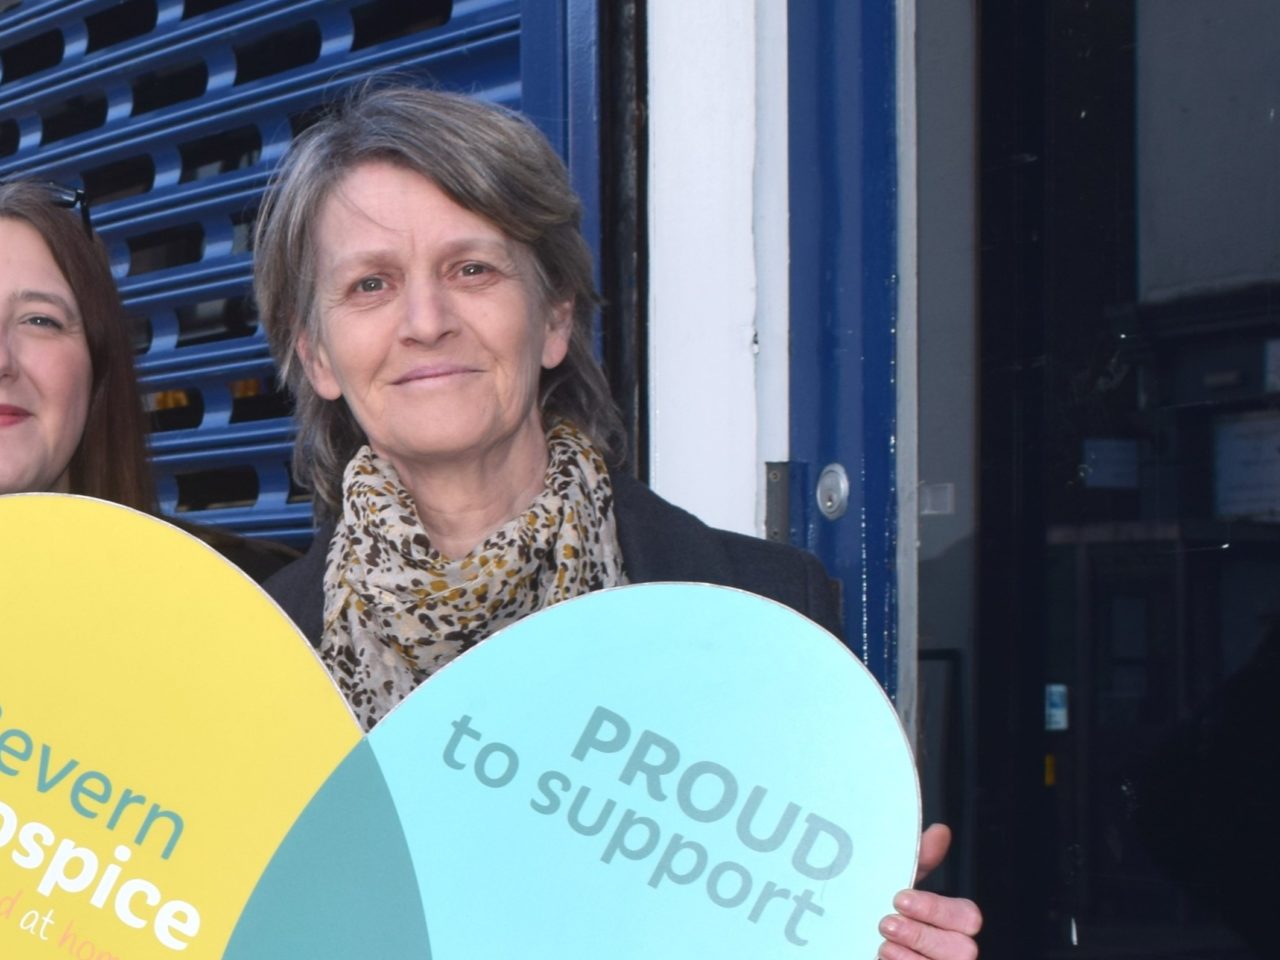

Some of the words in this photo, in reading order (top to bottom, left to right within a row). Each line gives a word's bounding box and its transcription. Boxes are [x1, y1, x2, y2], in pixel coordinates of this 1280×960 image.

[441, 713, 520, 790] to
[528, 768, 826, 948] support
[569, 704, 854, 882] PROUD
[18, 907, 56, 941] at
